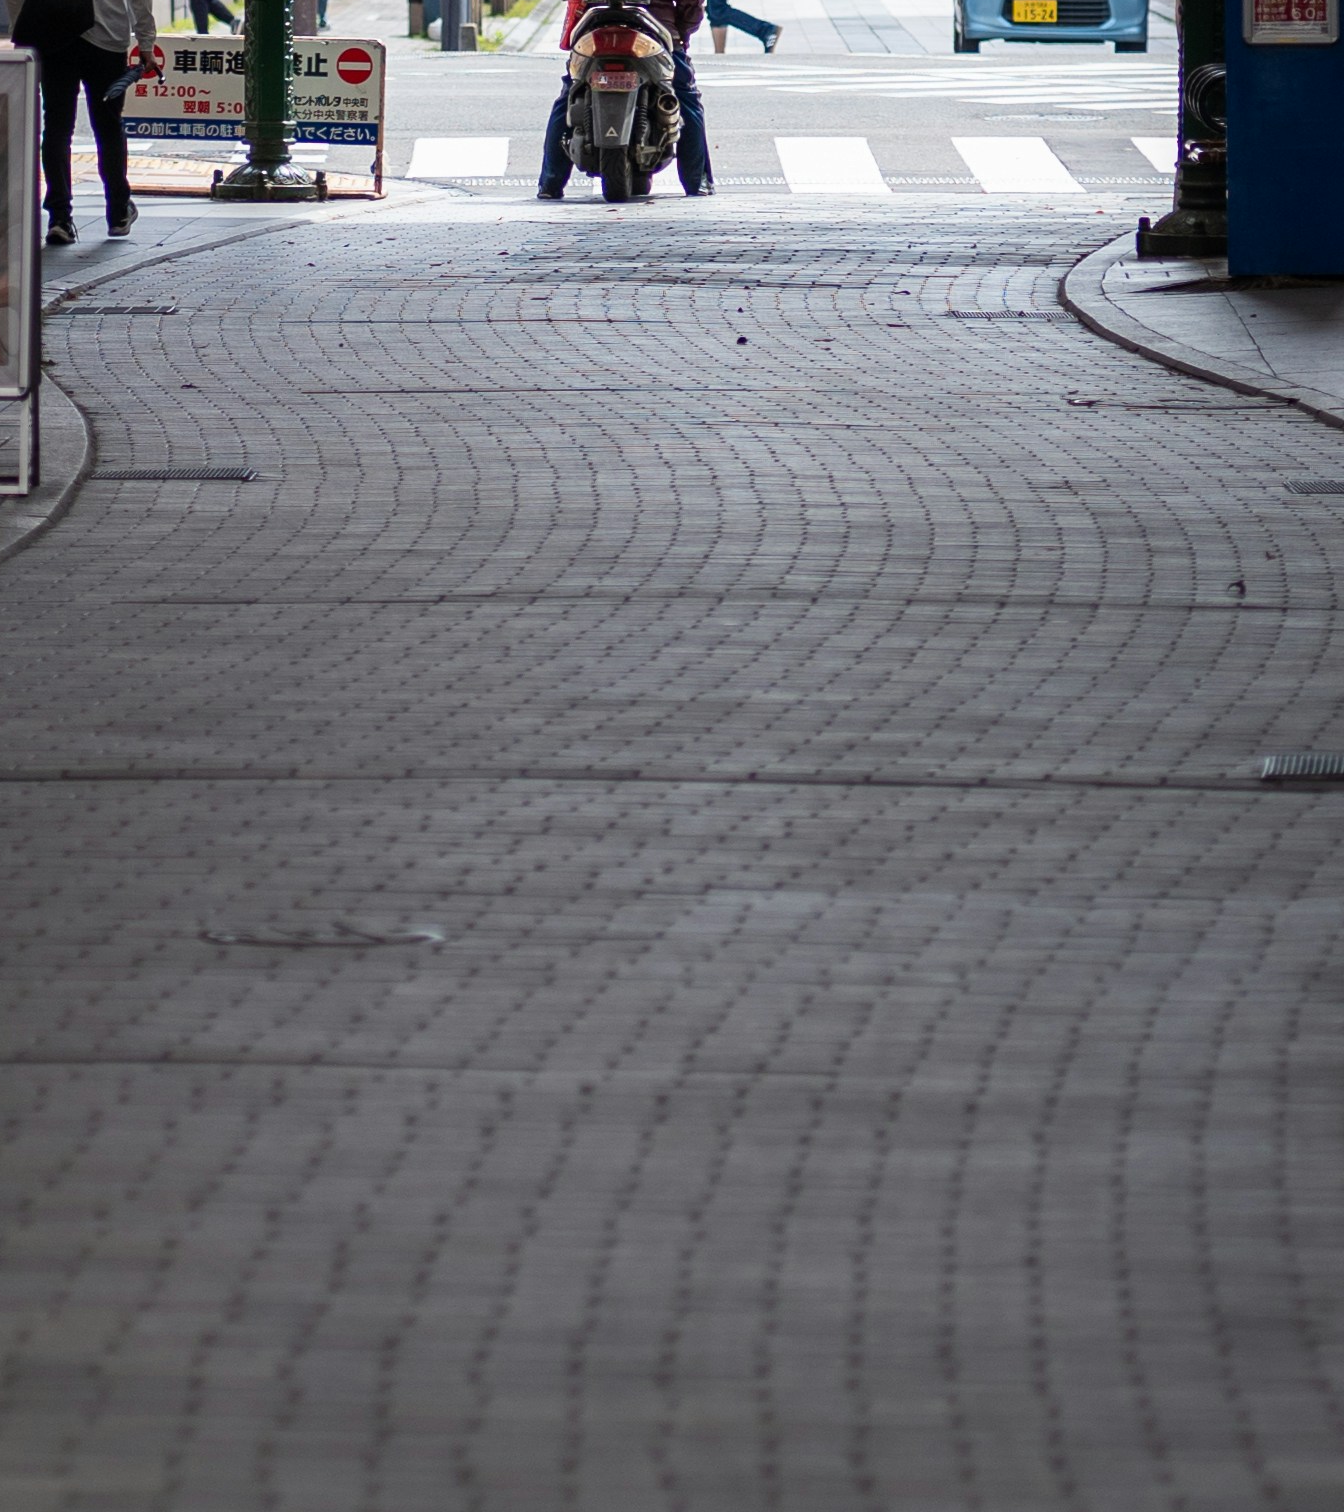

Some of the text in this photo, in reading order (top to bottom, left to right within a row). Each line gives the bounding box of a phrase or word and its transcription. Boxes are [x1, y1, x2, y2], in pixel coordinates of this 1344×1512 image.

[173, 49, 329, 77] 車輌進止
[134, 84, 148, 97] 昼
[183, 101, 245, 114] 翌朝 5:0
[293, 95, 369, 108] セントポルタ 中央町
[292, 108, 369, 121] 大分中央警察署
[124, 121, 377, 142] この前に車両の駐車いでください。
